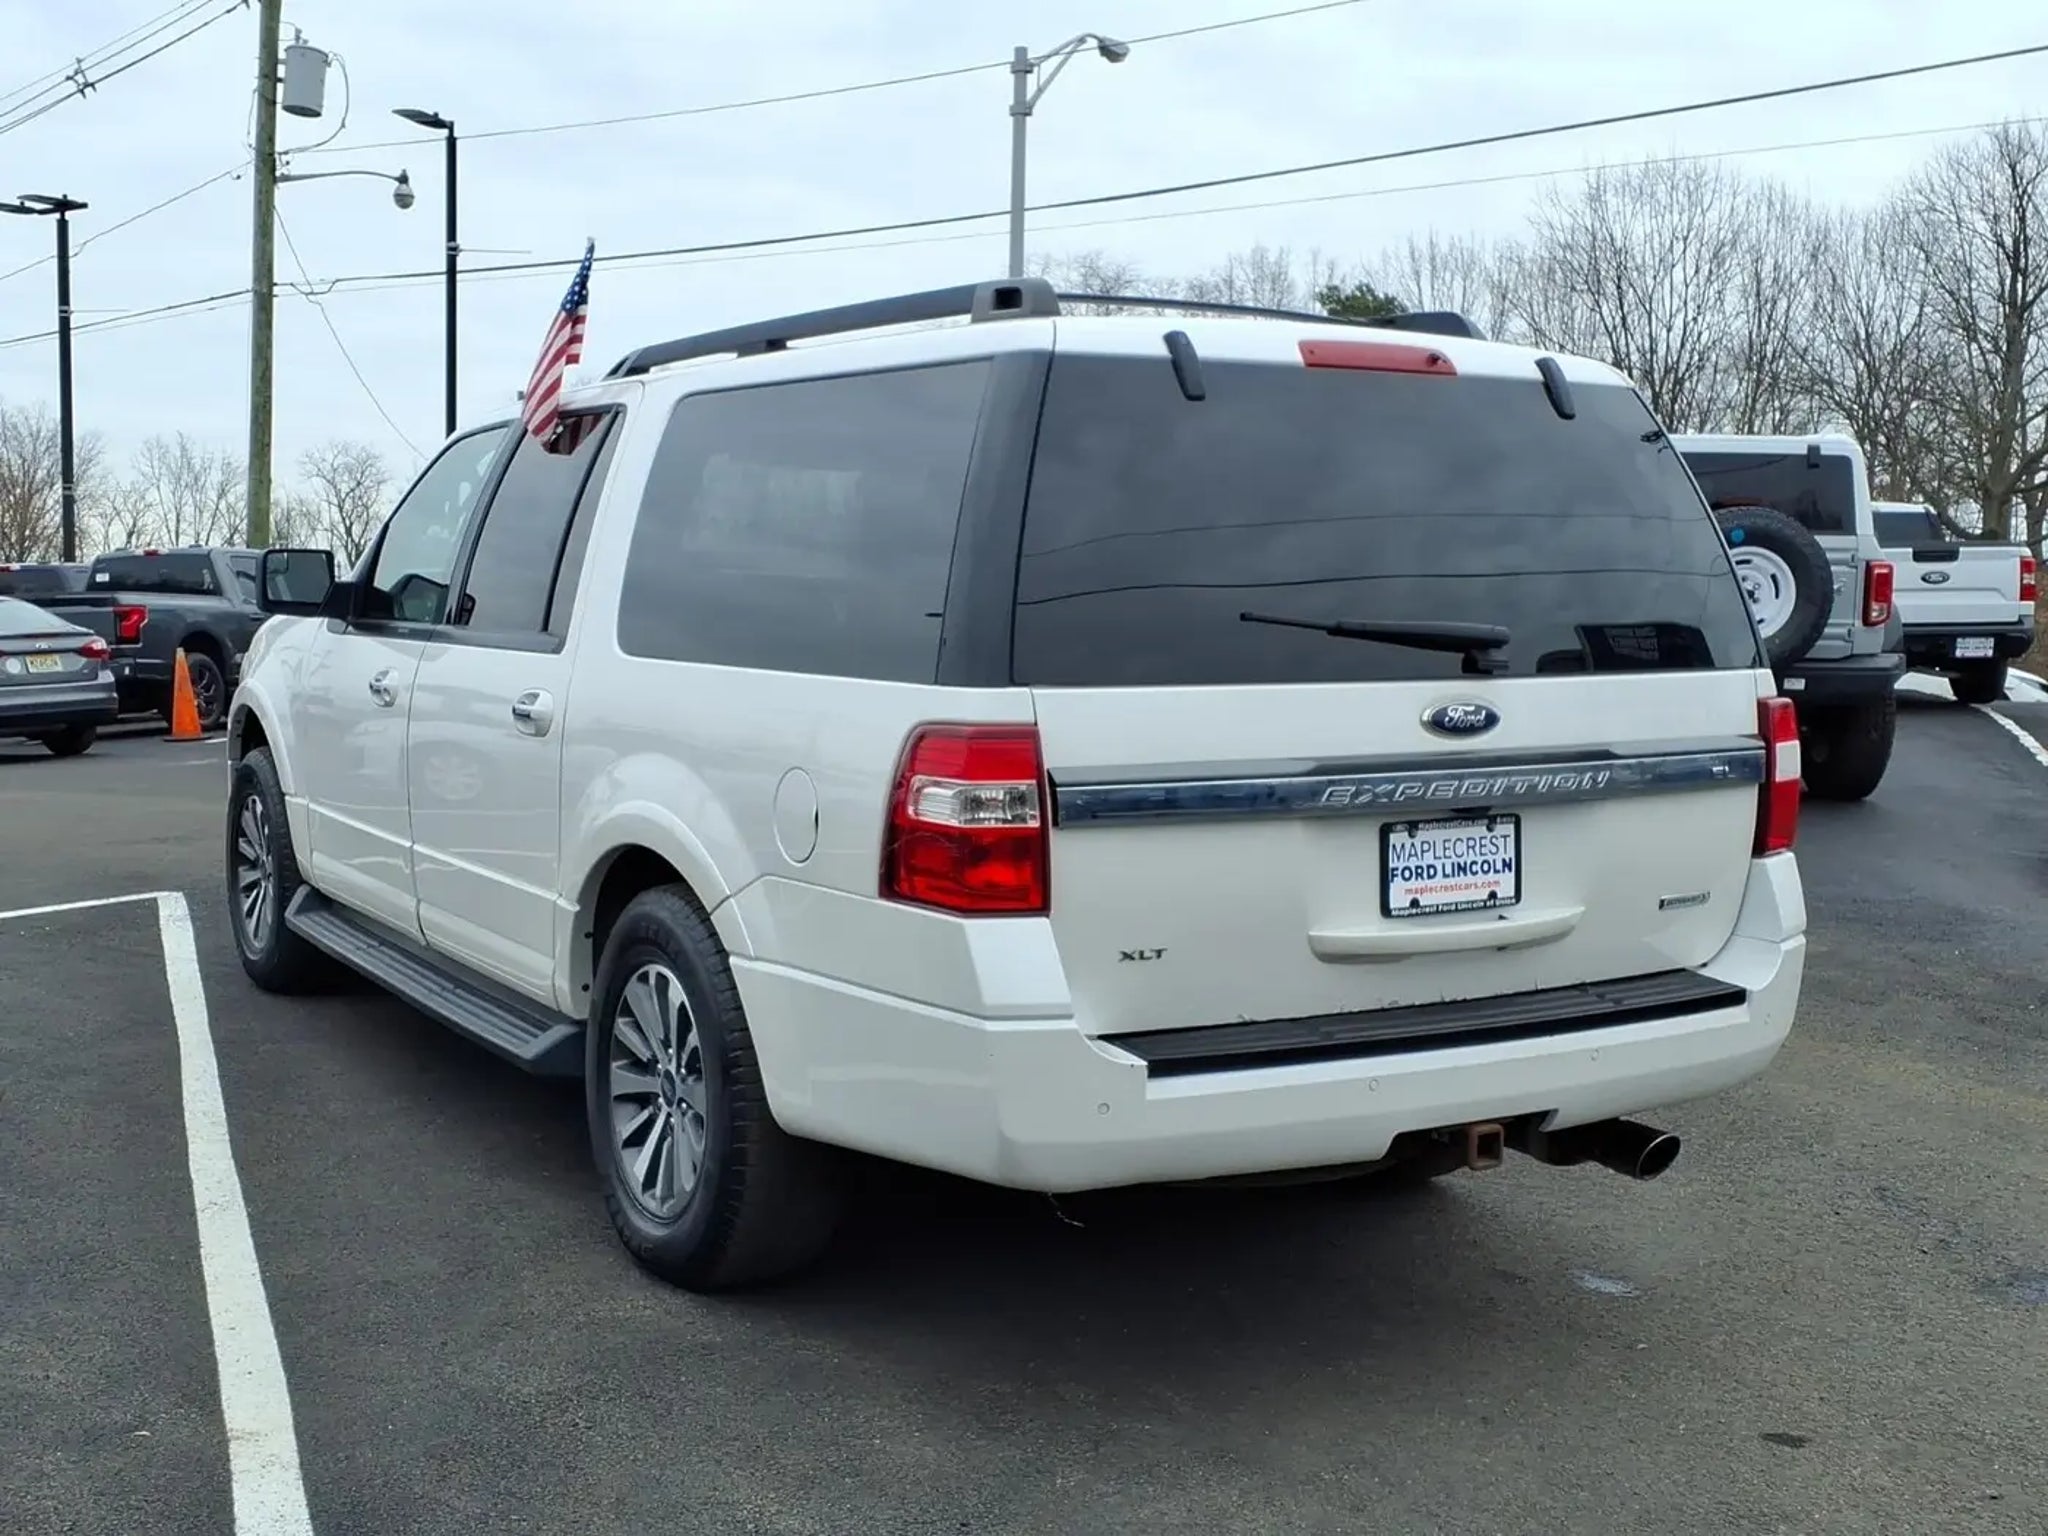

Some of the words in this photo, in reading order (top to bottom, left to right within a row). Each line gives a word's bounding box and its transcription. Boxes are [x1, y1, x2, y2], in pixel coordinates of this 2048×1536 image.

[1444, 705, 1486, 728] Ford
[1320, 770, 1611, 805] EXPEDITION
[1391, 834, 1511, 863] MAPLECREST
[1390, 863, 1438, 883] FORD
[1442, 857, 1513, 879] LINCOLN
[1404, 880, 1501, 897] maplecrestcars.com
[1118, 947, 1169, 962] XLT
